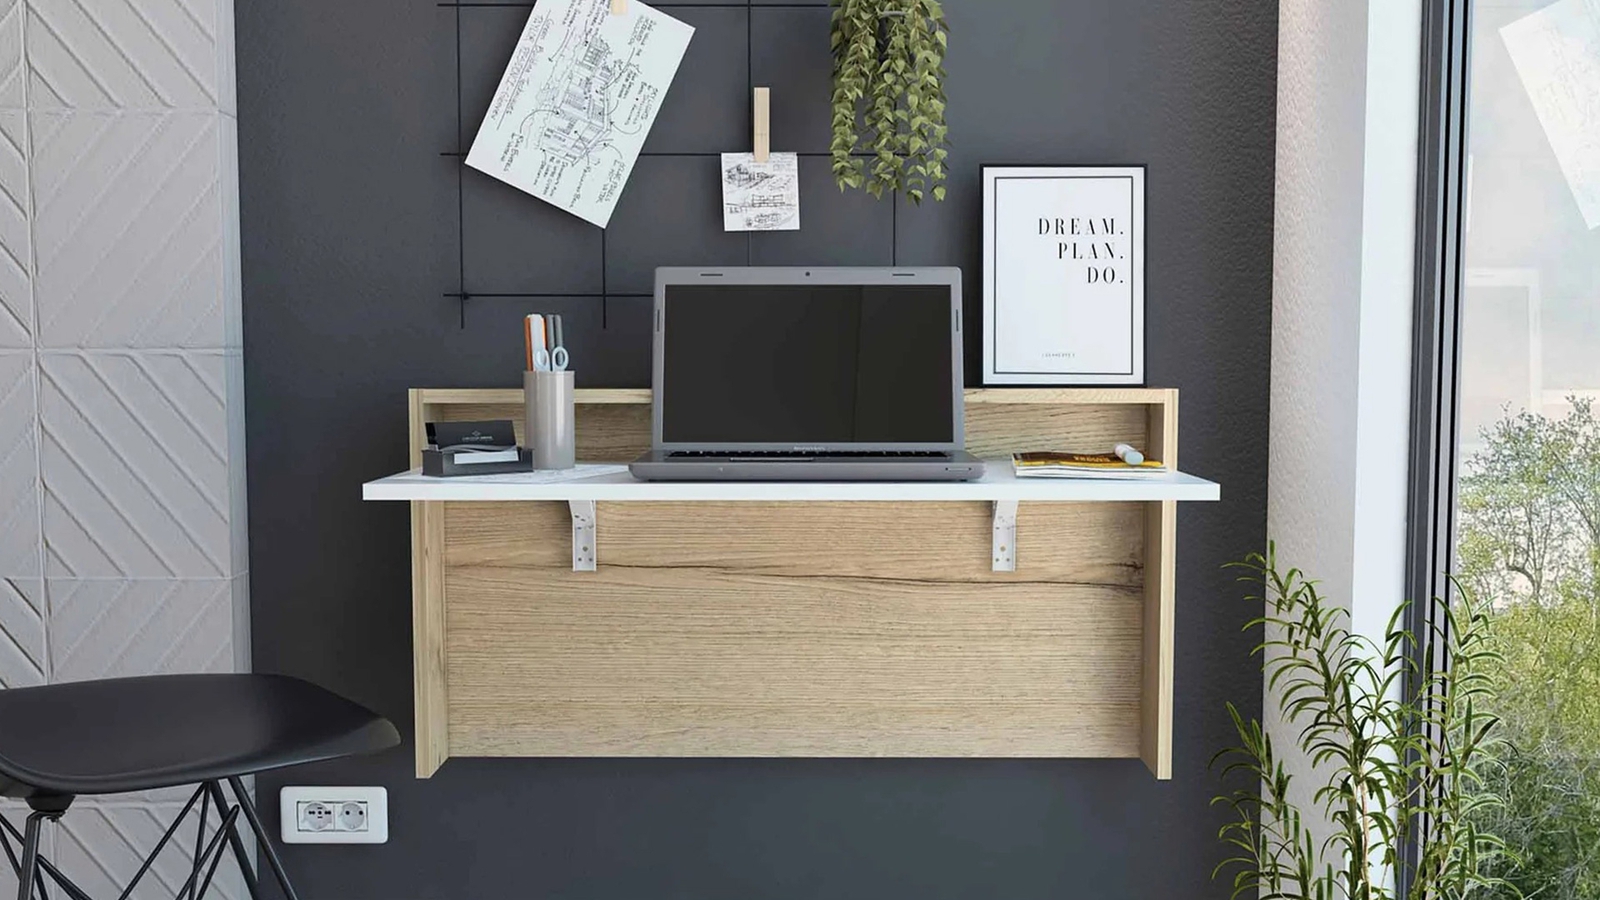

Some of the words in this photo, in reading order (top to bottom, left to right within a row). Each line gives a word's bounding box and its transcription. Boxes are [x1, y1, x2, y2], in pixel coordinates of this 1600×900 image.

[1039, 218, 1123, 235] DREAM.
[1059, 242, 1123, 259] PLAN.
[1088, 267, 1123, 284] DO.
